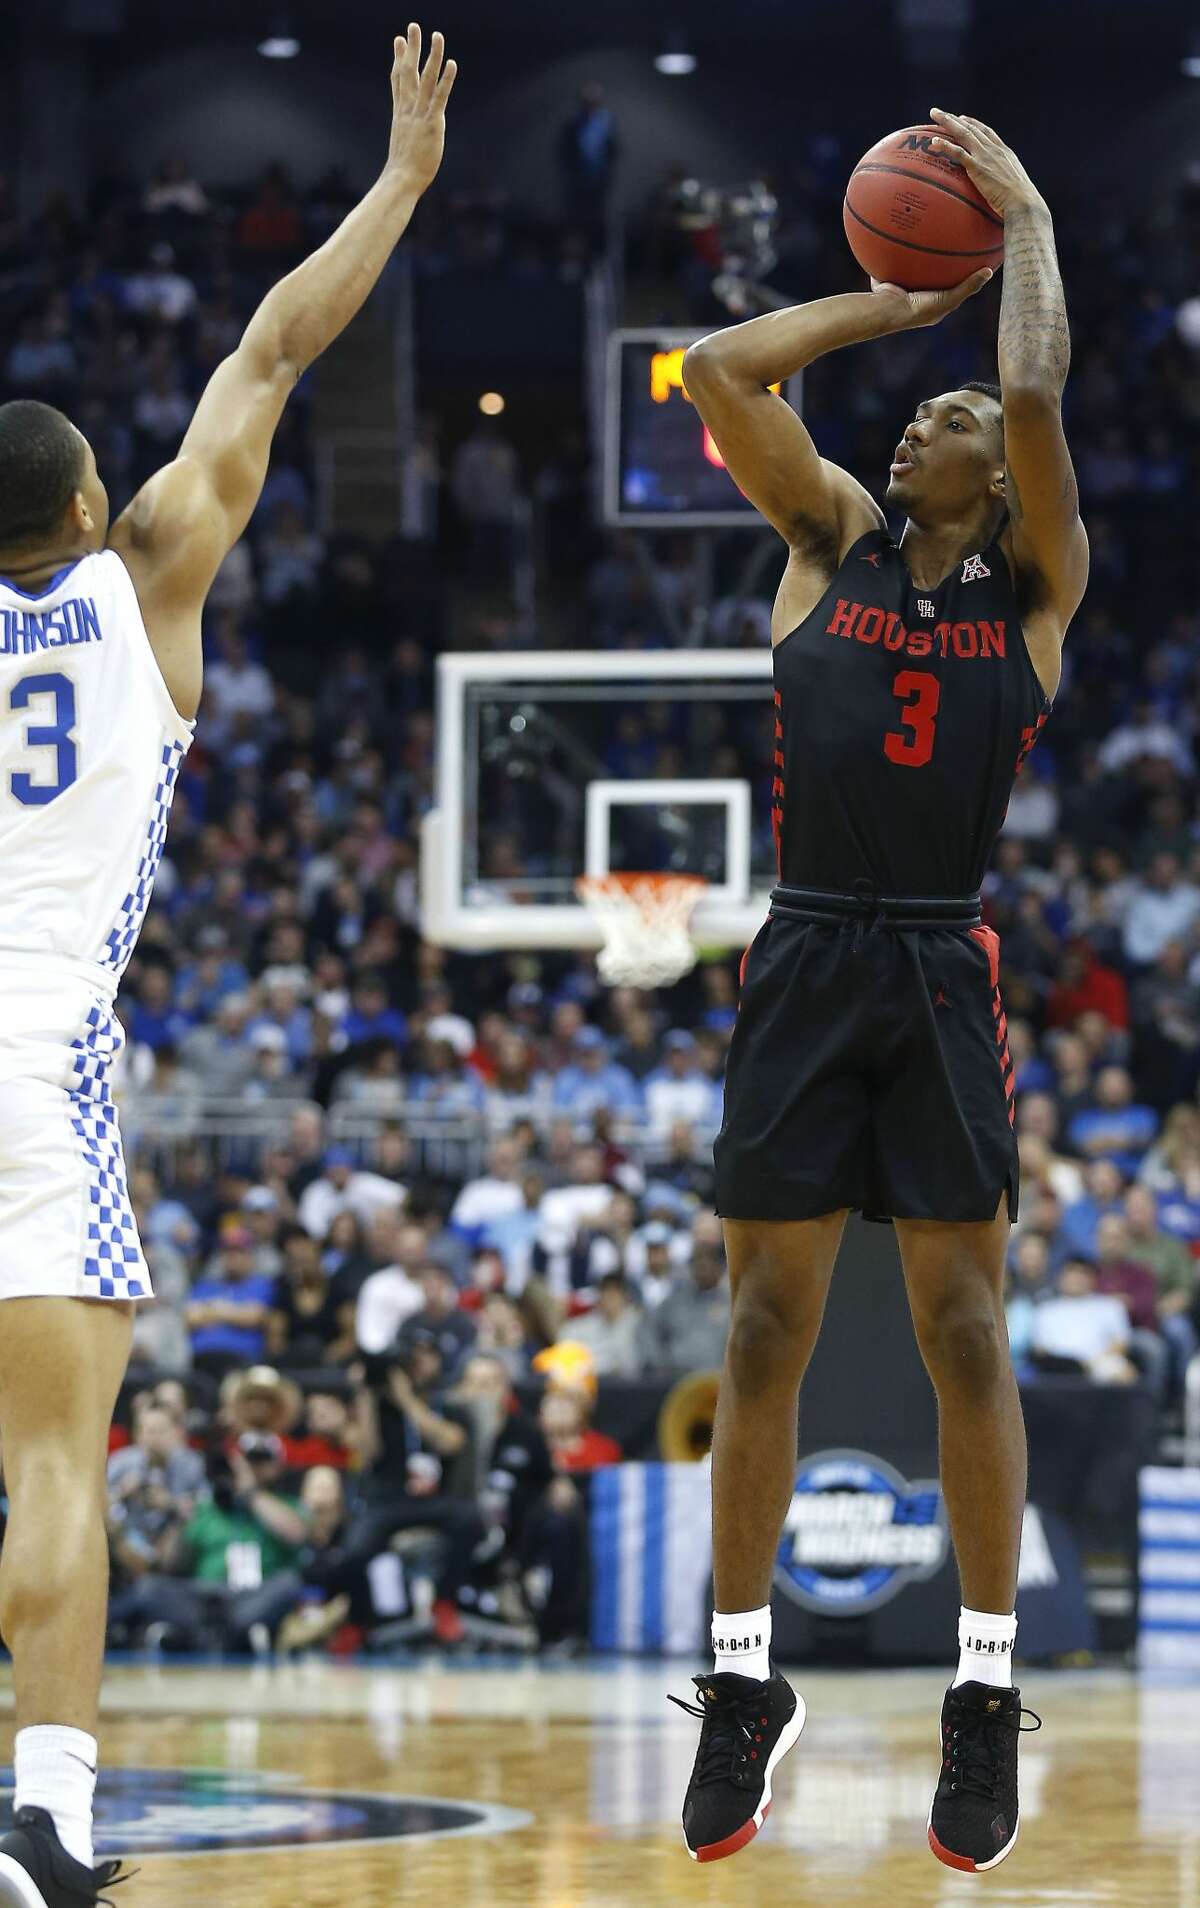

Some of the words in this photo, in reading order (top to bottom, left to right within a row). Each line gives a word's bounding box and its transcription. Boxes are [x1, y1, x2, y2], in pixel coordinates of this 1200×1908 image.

[825, 597, 1007, 660] HOUSTON
[10, 672, 77, 806] 3
[884, 671, 941, 768] 3
